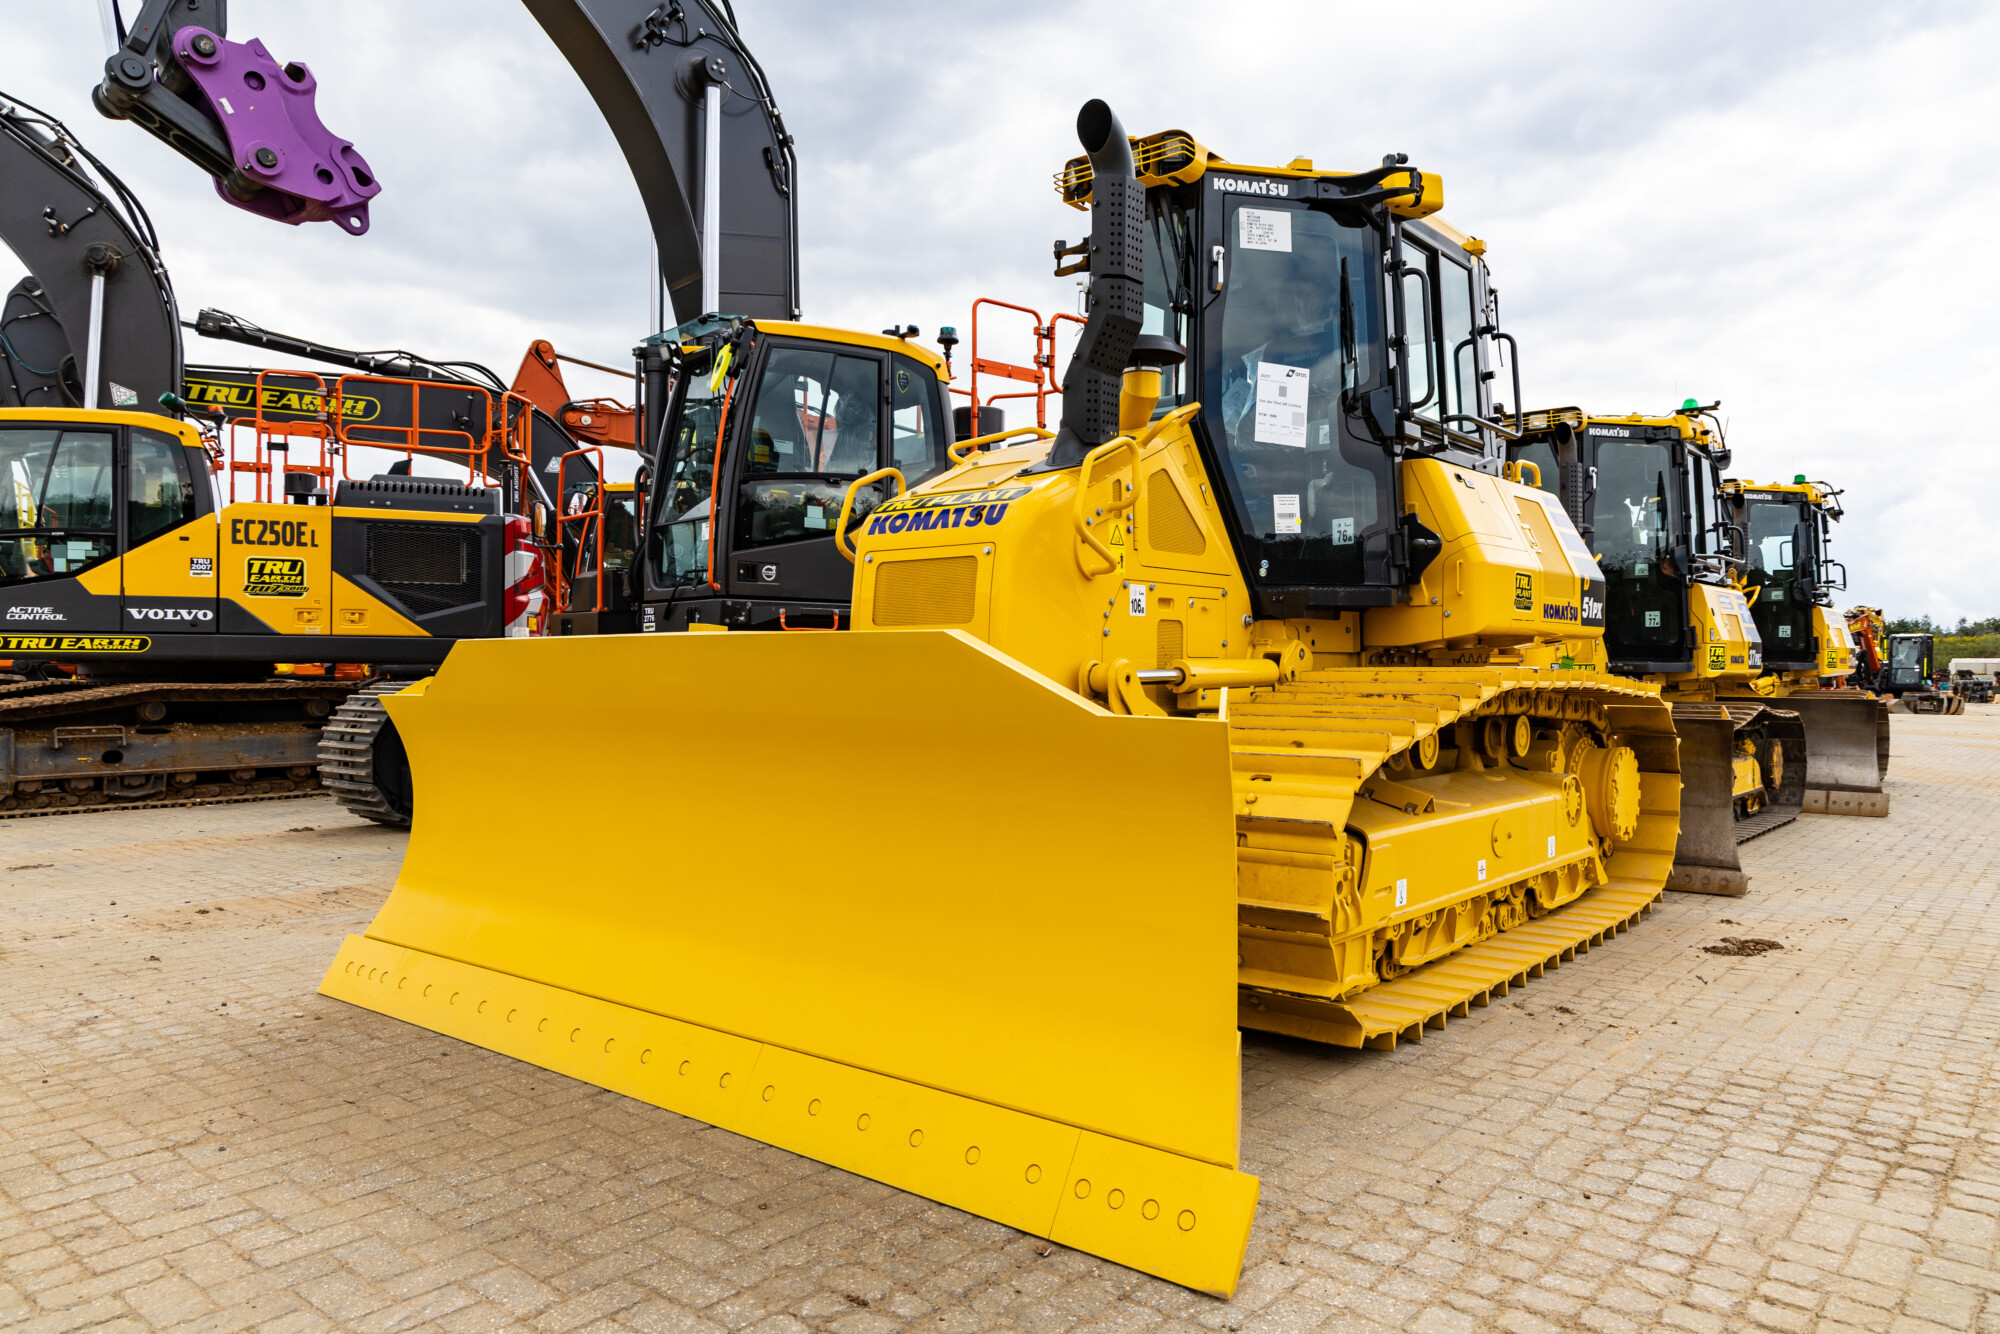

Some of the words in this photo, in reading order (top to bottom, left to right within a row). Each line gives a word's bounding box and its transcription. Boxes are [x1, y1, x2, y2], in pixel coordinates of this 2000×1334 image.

[1213, 178, 1288, 196] KOMATSU
[186, 383, 254, 404] TRU
[261, 391, 367, 410] EARTH
[1589, 427, 1630, 438] KOMATSU
[875, 497, 926, 513] TRU
[925, 487, 1024, 506] PLANT
[867, 502, 1010, 536] KOMATSU
[249, 560, 303, 575] TRU
[249, 574, 303, 584] EARTH
[1515, 575, 1532, 589] TRU
[1515, 588, 1532, 598] PLANT
[7, 606, 54, 614] ACTIVE
[127, 608, 214, 621] VOLVO
[1543, 602, 1579, 621] KOMATSU
[6, 613, 68, 621] CONTROL
[7, 637, 57, 649] TRU
[60, 638, 141, 649] EARTH
